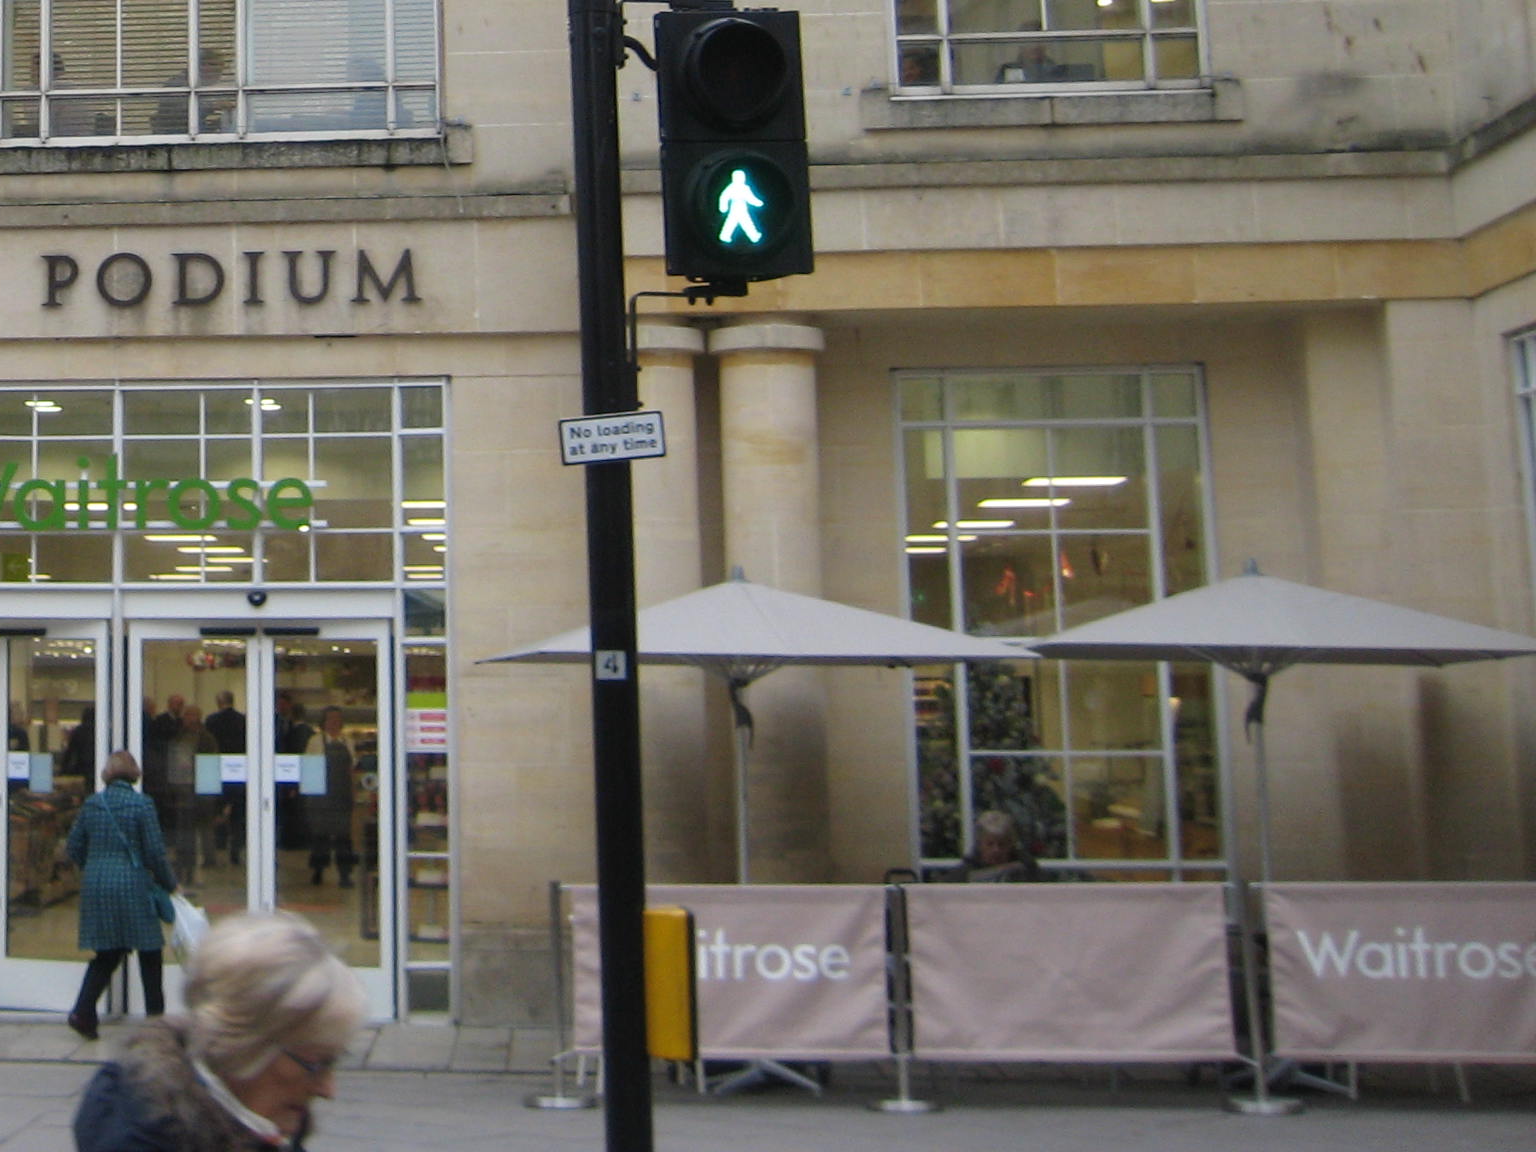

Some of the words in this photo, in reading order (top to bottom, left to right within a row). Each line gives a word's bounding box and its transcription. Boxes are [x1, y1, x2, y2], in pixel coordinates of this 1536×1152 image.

[40, 248, 423, 307] PODIUM
[569, 427, 593, 439] No
[596, 422, 655, 437] loading
[569, 442, 586, 456] at
[591, 442, 617, 455] any
[623, 437, 658, 450] time
[698, 927, 850, 980] itrose
